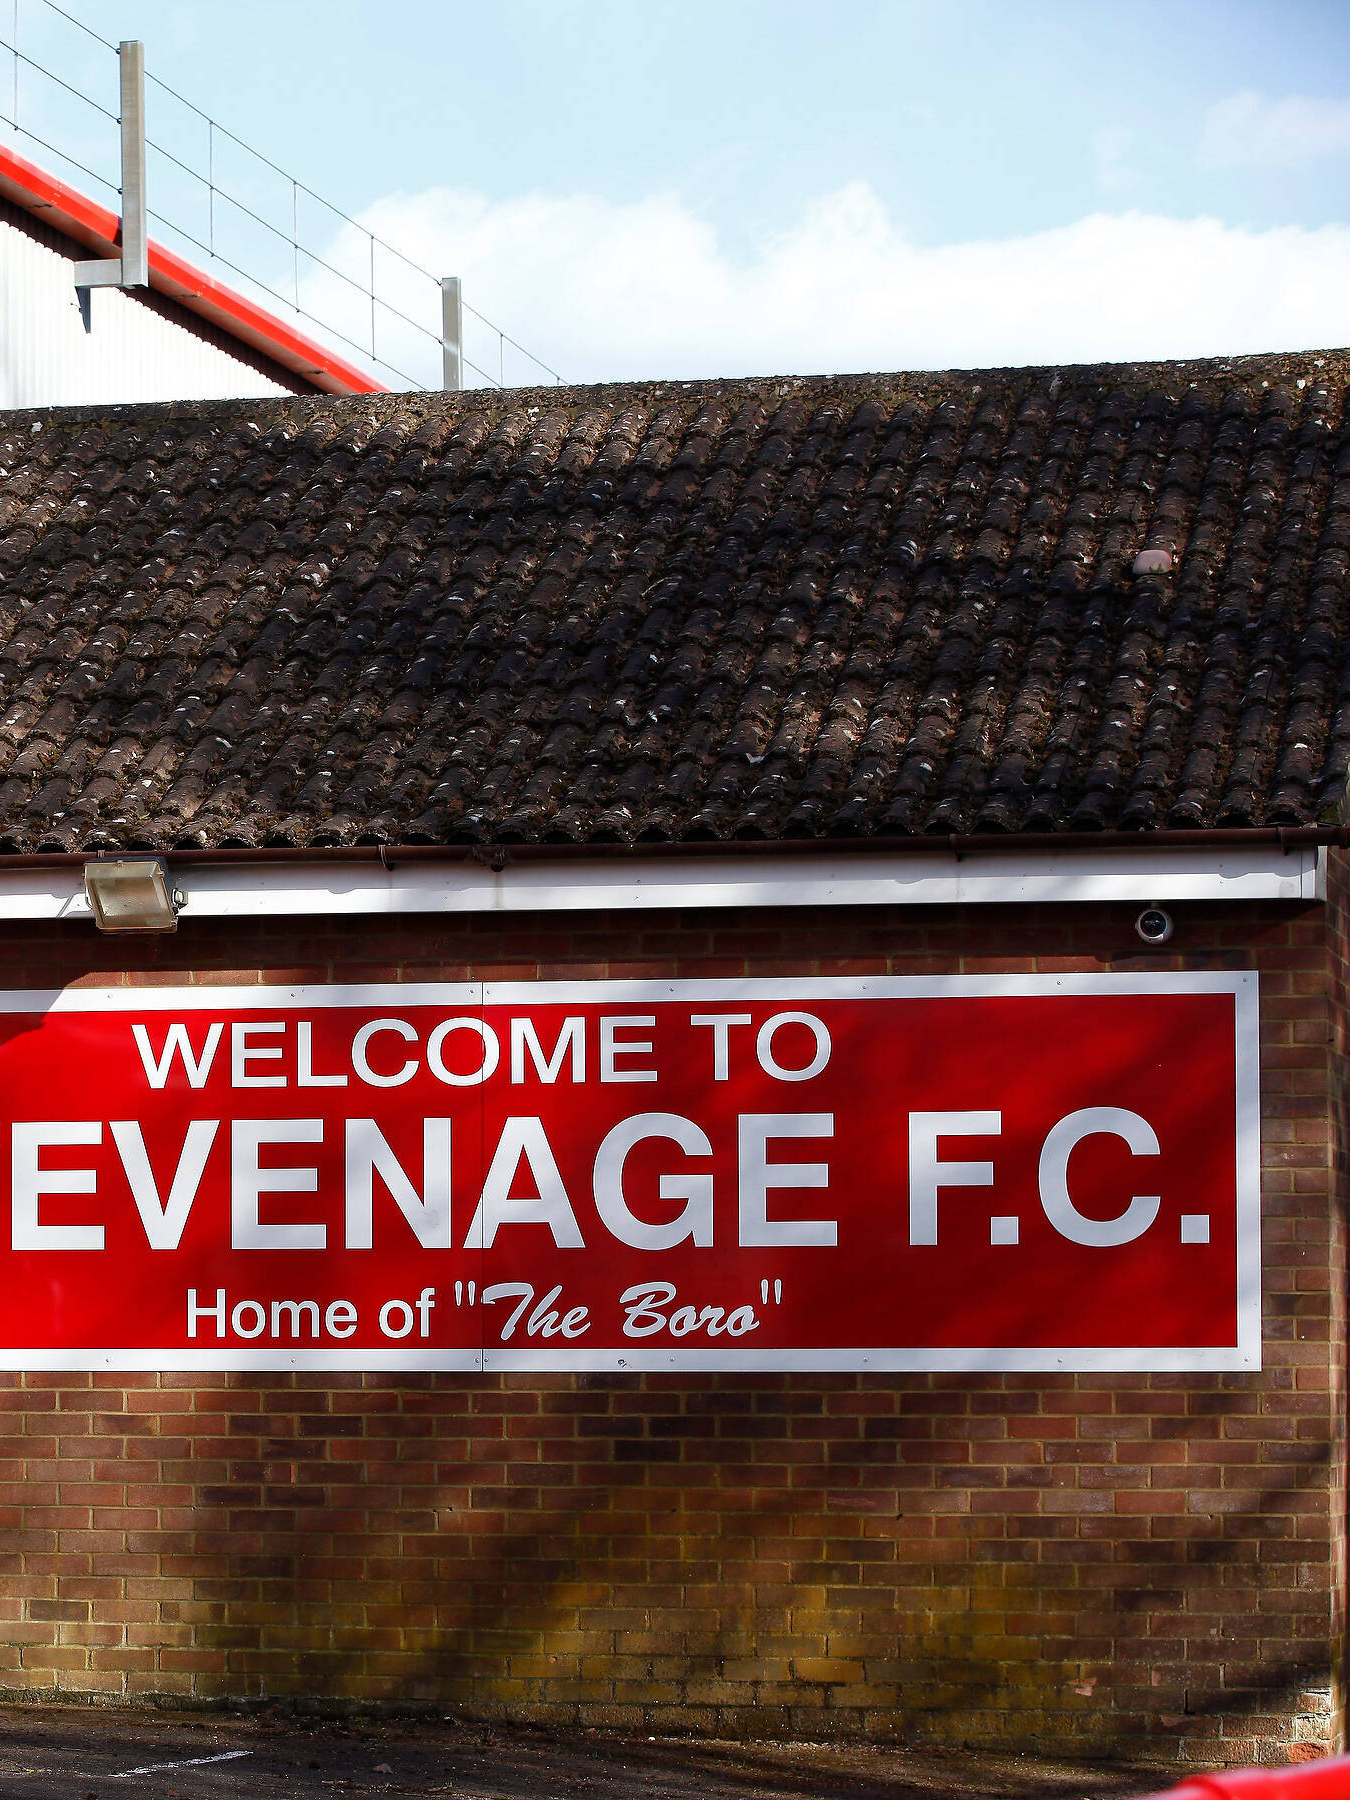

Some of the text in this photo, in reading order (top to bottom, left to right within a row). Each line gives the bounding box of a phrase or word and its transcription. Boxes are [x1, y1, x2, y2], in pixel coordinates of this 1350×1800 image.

[130, 1011, 832, 1089] WELCOME TO
[908, 1106, 1210, 1247] F.C.
[187, 1278, 783, 1341] Home of "The Boro"
